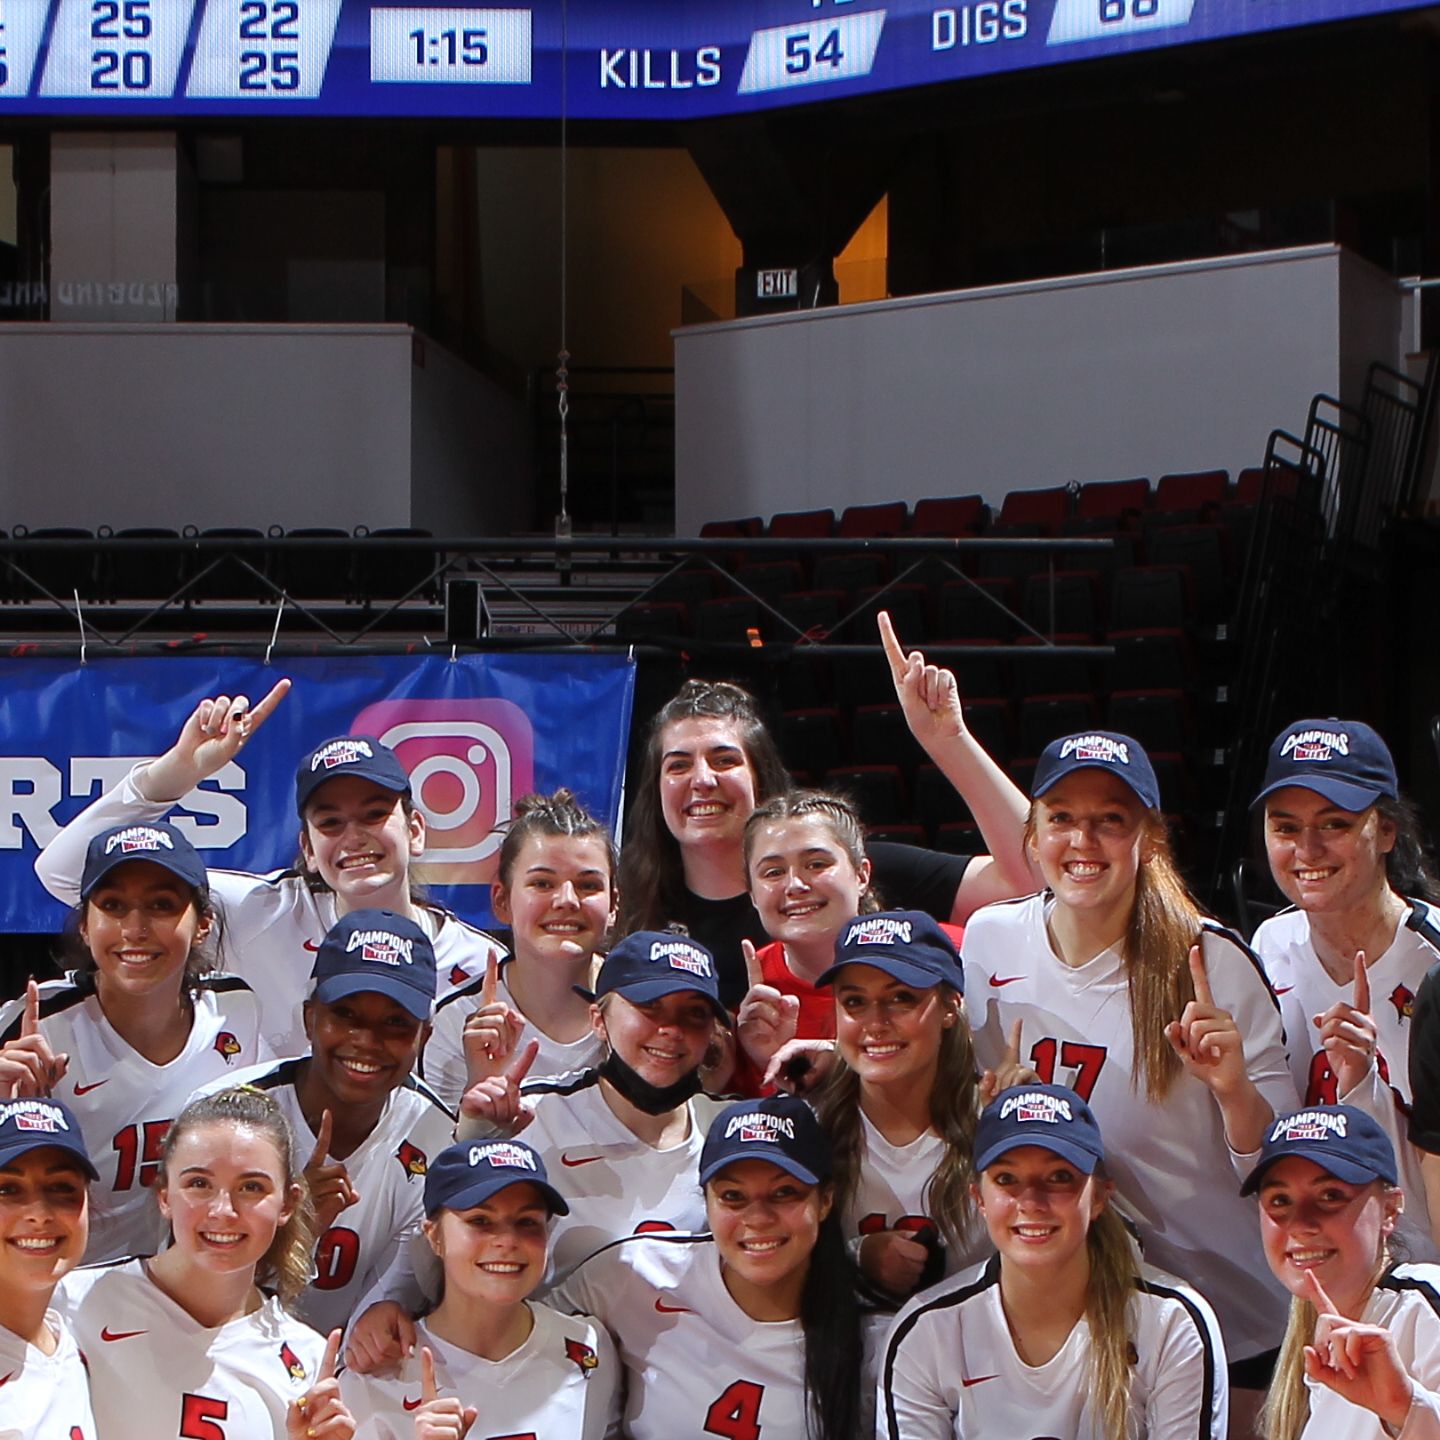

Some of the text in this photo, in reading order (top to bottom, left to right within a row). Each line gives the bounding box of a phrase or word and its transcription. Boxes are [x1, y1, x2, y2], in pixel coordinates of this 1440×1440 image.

[91, 0, 153, 39] 25
[239, 0, 301, 40] 22
[932, 0, 1028, 52] DIGS
[409, 29, 490, 68] 1:15
[785, 28, 845, 75] 54
[91, 49, 153, 90] 20
[239, 49, 302, 91] 25
[600, 47, 721, 89] KILLS
[762, 271, 792, 296] EXIT
[311, 741, 373, 771] CHAMPIONS
[1059, 736, 1129, 764] CHAMPIONS
[1280, 731, 1349, 757] CHAMPIONS
[105, 827, 174, 855] CHAMPIONS
[345, 930, 413, 964] CHAMPIONS
[844, 919, 912, 946] CHAMPIONS
[1030, 1037, 1108, 1104] 17
[1000, 1093, 1073, 1121] CHAMPIONS
[724, 1113, 795, 1140] CHAMPIONS
[1270, 1112, 1347, 1142] CHAMPIONS
[113, 1118, 175, 1193] 15
[469, 1143, 537, 1171] CHAMPIONS
